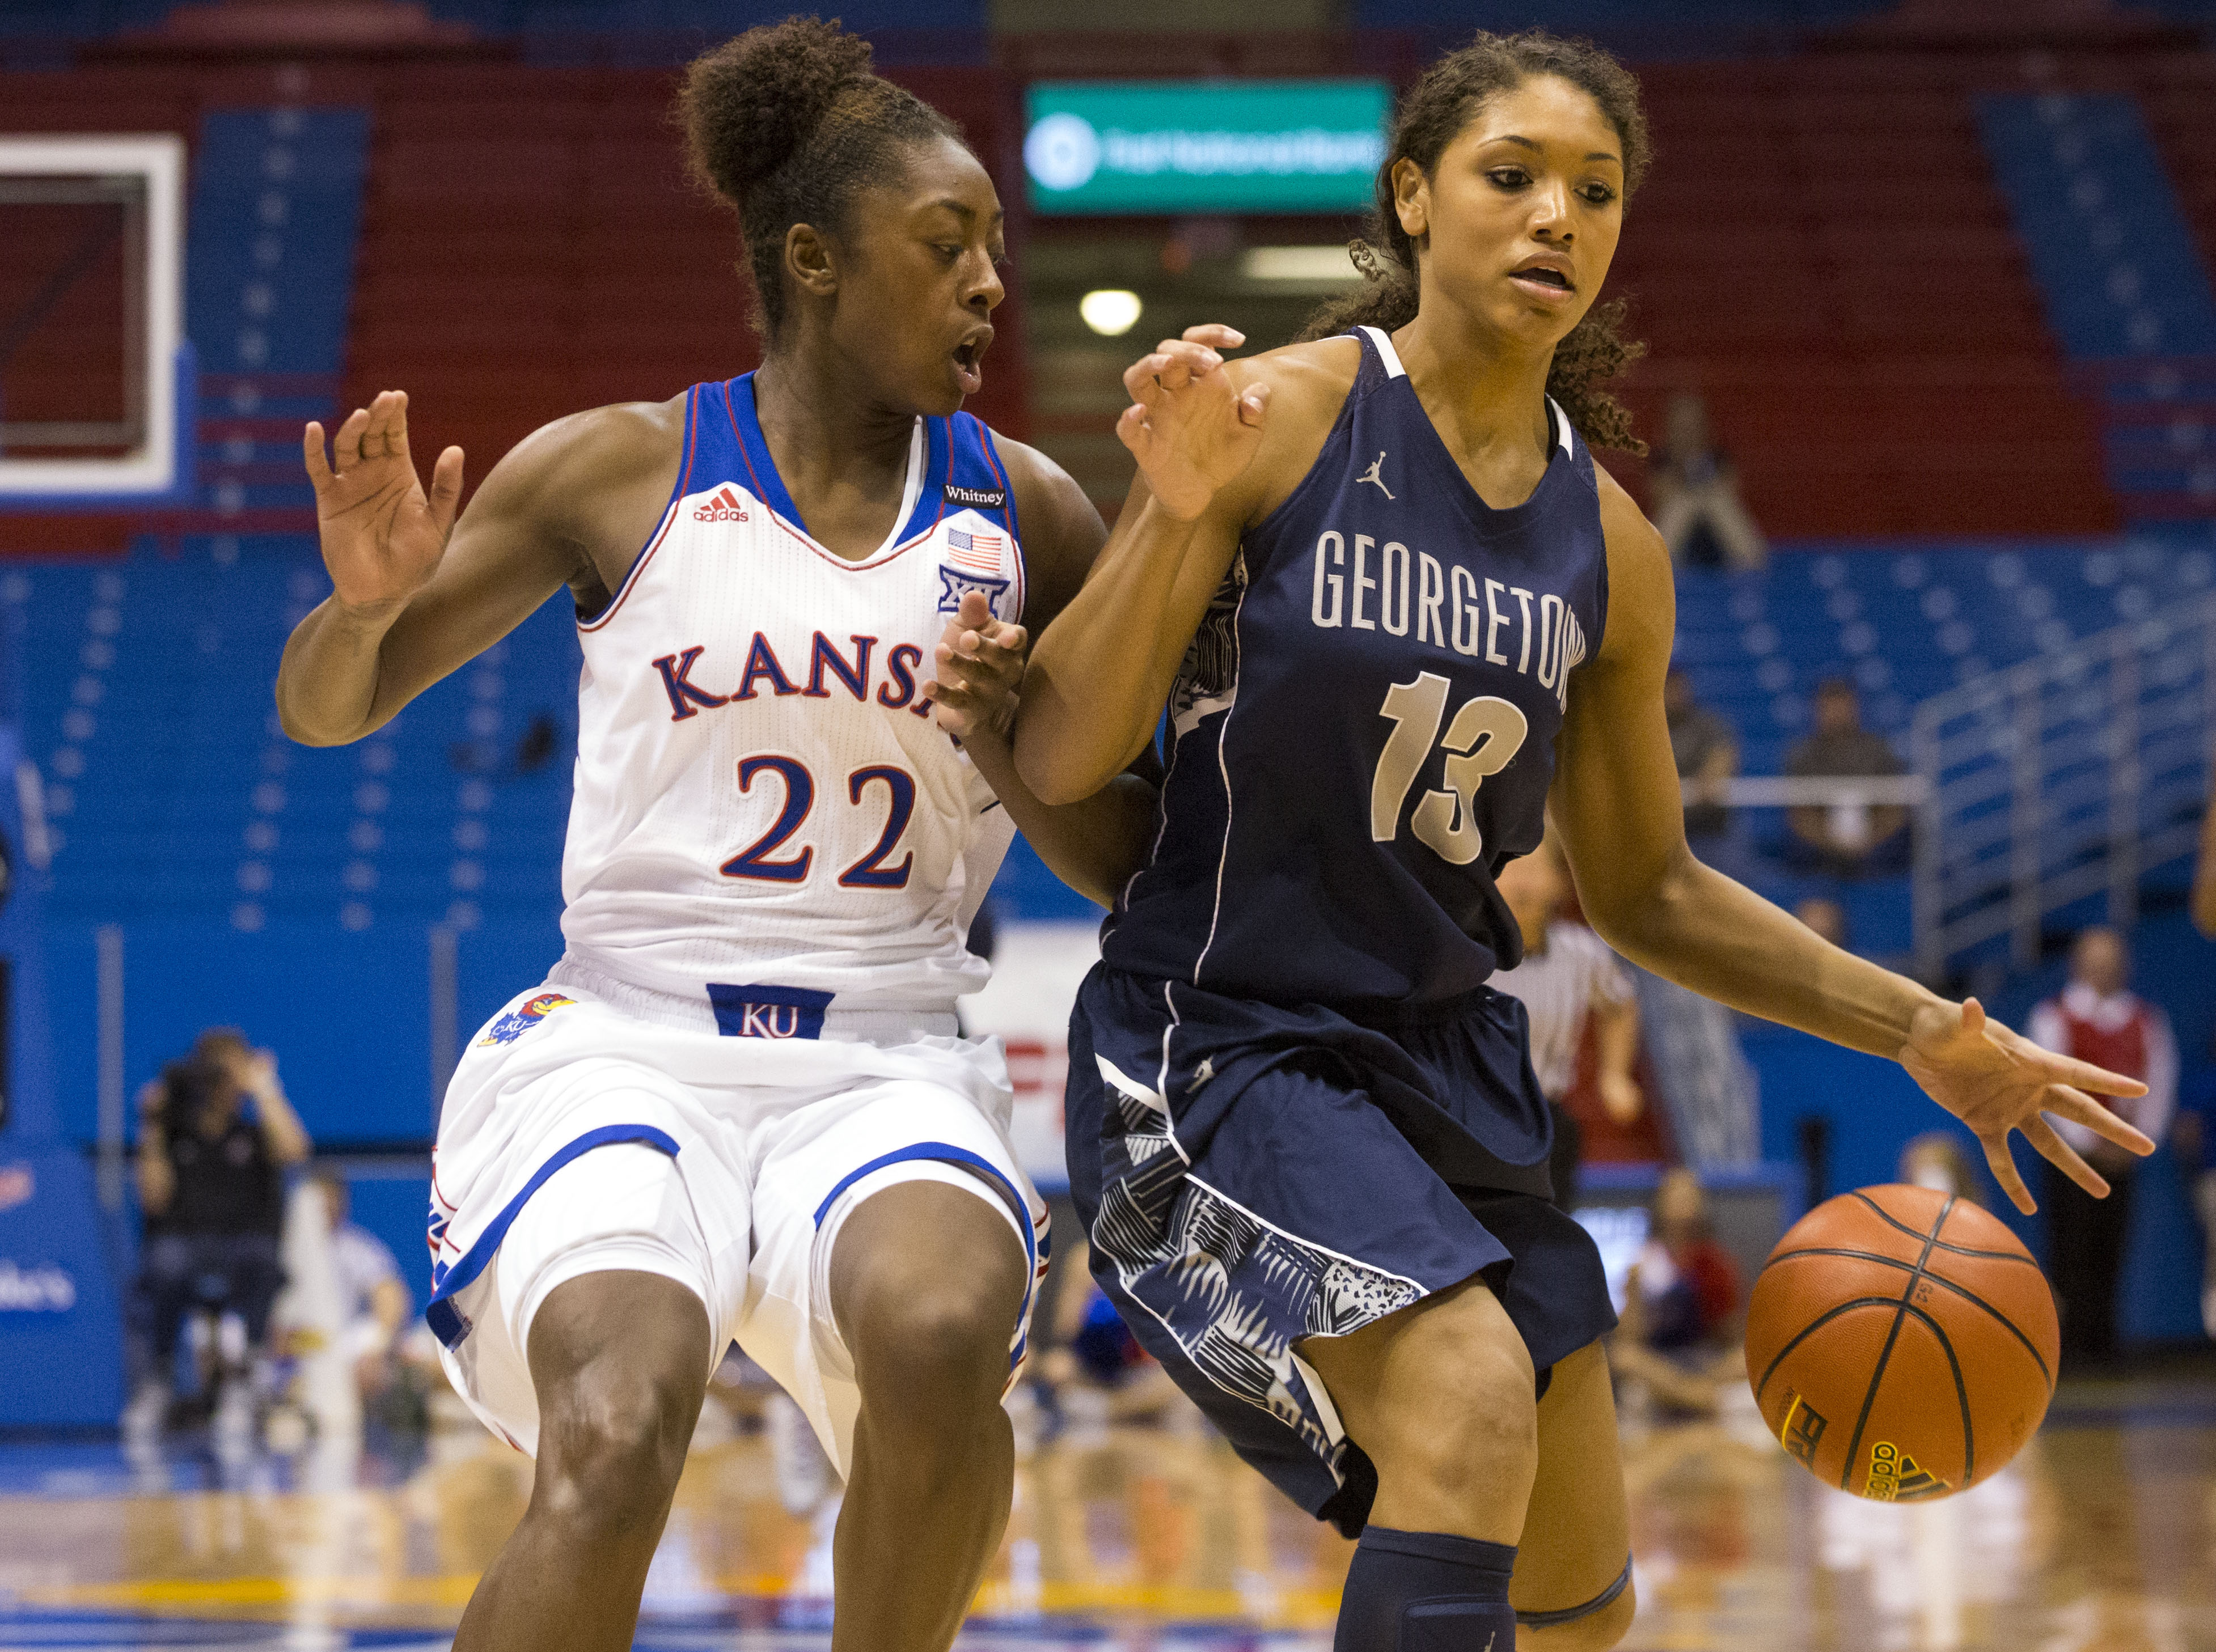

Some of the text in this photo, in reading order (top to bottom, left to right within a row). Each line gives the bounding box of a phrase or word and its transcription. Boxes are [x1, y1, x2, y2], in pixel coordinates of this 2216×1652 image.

[946, 485, 1004, 506] Whitney
[693, 508, 748, 522] adidas
[1371, 671, 1528, 865] 13
[719, 754, 916, 889] 22
[738, 1002, 801, 1039] KU
